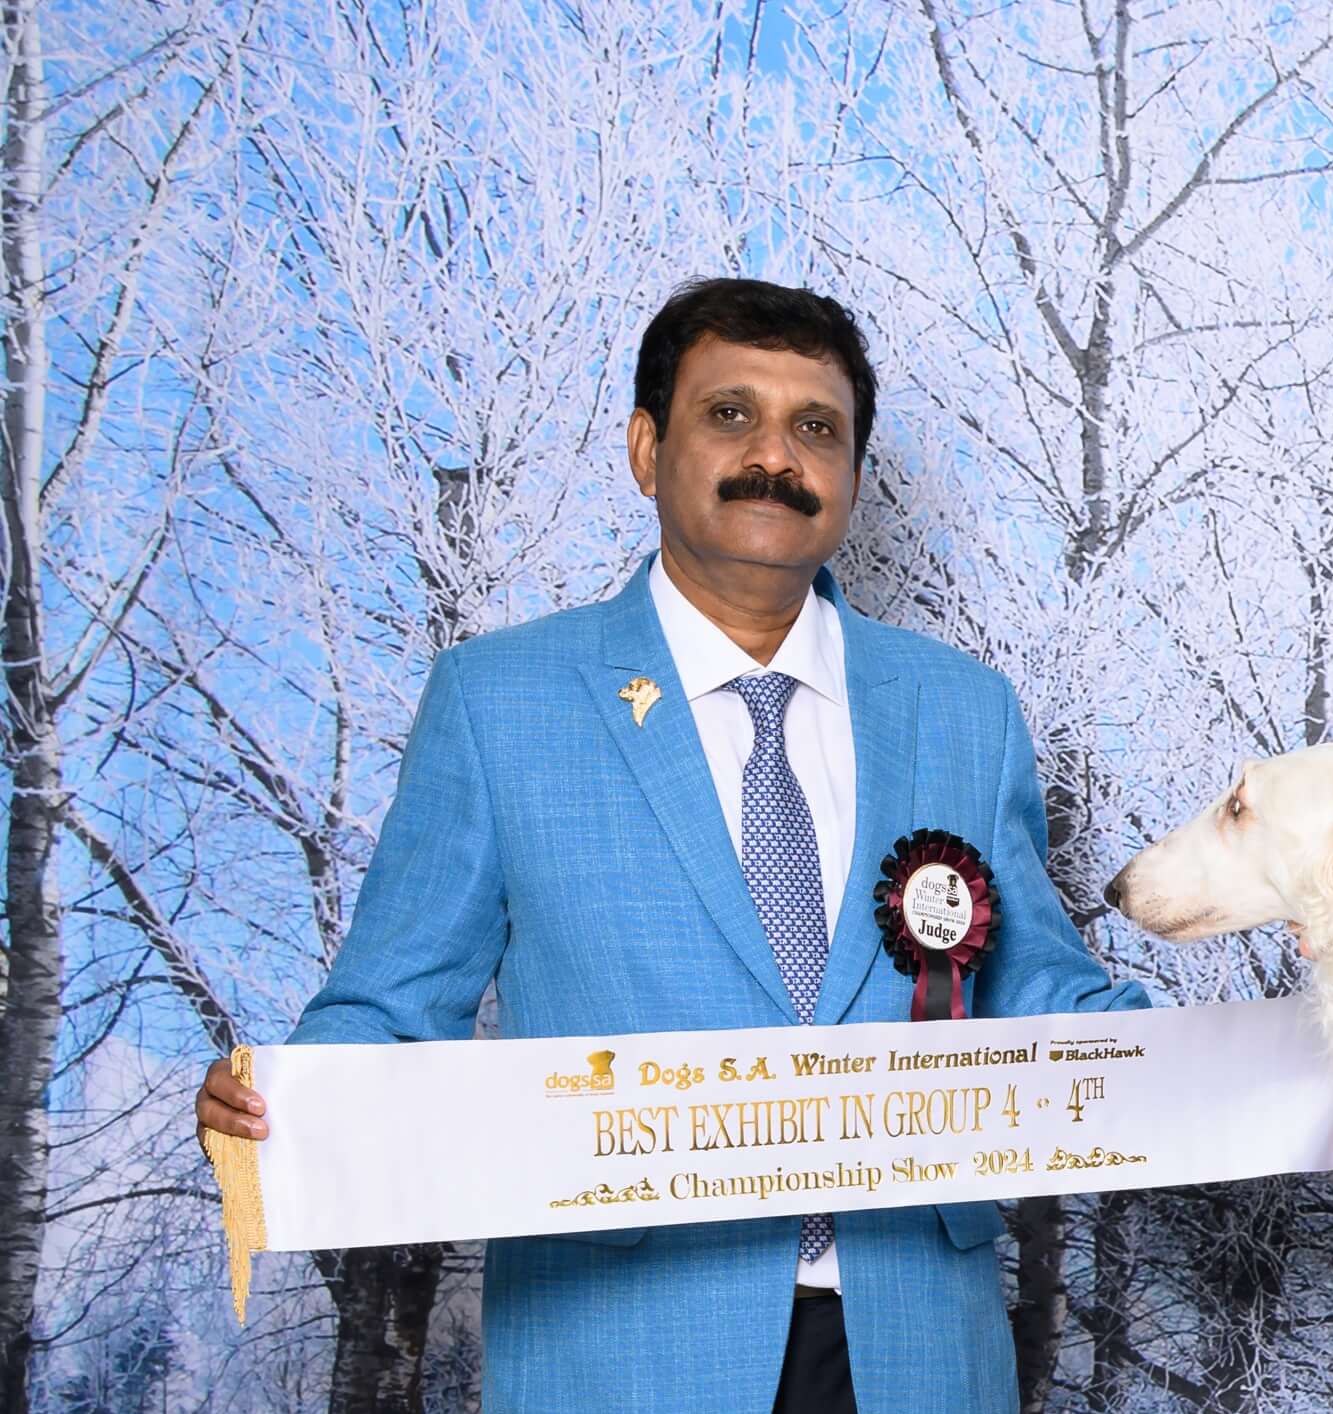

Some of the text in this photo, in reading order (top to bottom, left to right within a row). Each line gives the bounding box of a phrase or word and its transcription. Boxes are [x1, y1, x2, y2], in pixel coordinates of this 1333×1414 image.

[918, 919, 957, 944] Judge
[638, 1042, 1038, 1090] Dogs S.A. Winter International
[1065, 1045, 1146, 1061] BlackHawk
[592, 1105, 679, 1157] BEST
[688, 1096, 831, 1151] EXHIBIT
[840, 1093, 875, 1142] IN
[883, 1086, 992, 1138] GROUP
[1002, 1083, 1020, 1128] 4
[670, 1147, 1035, 1200] Championship Show 2024
